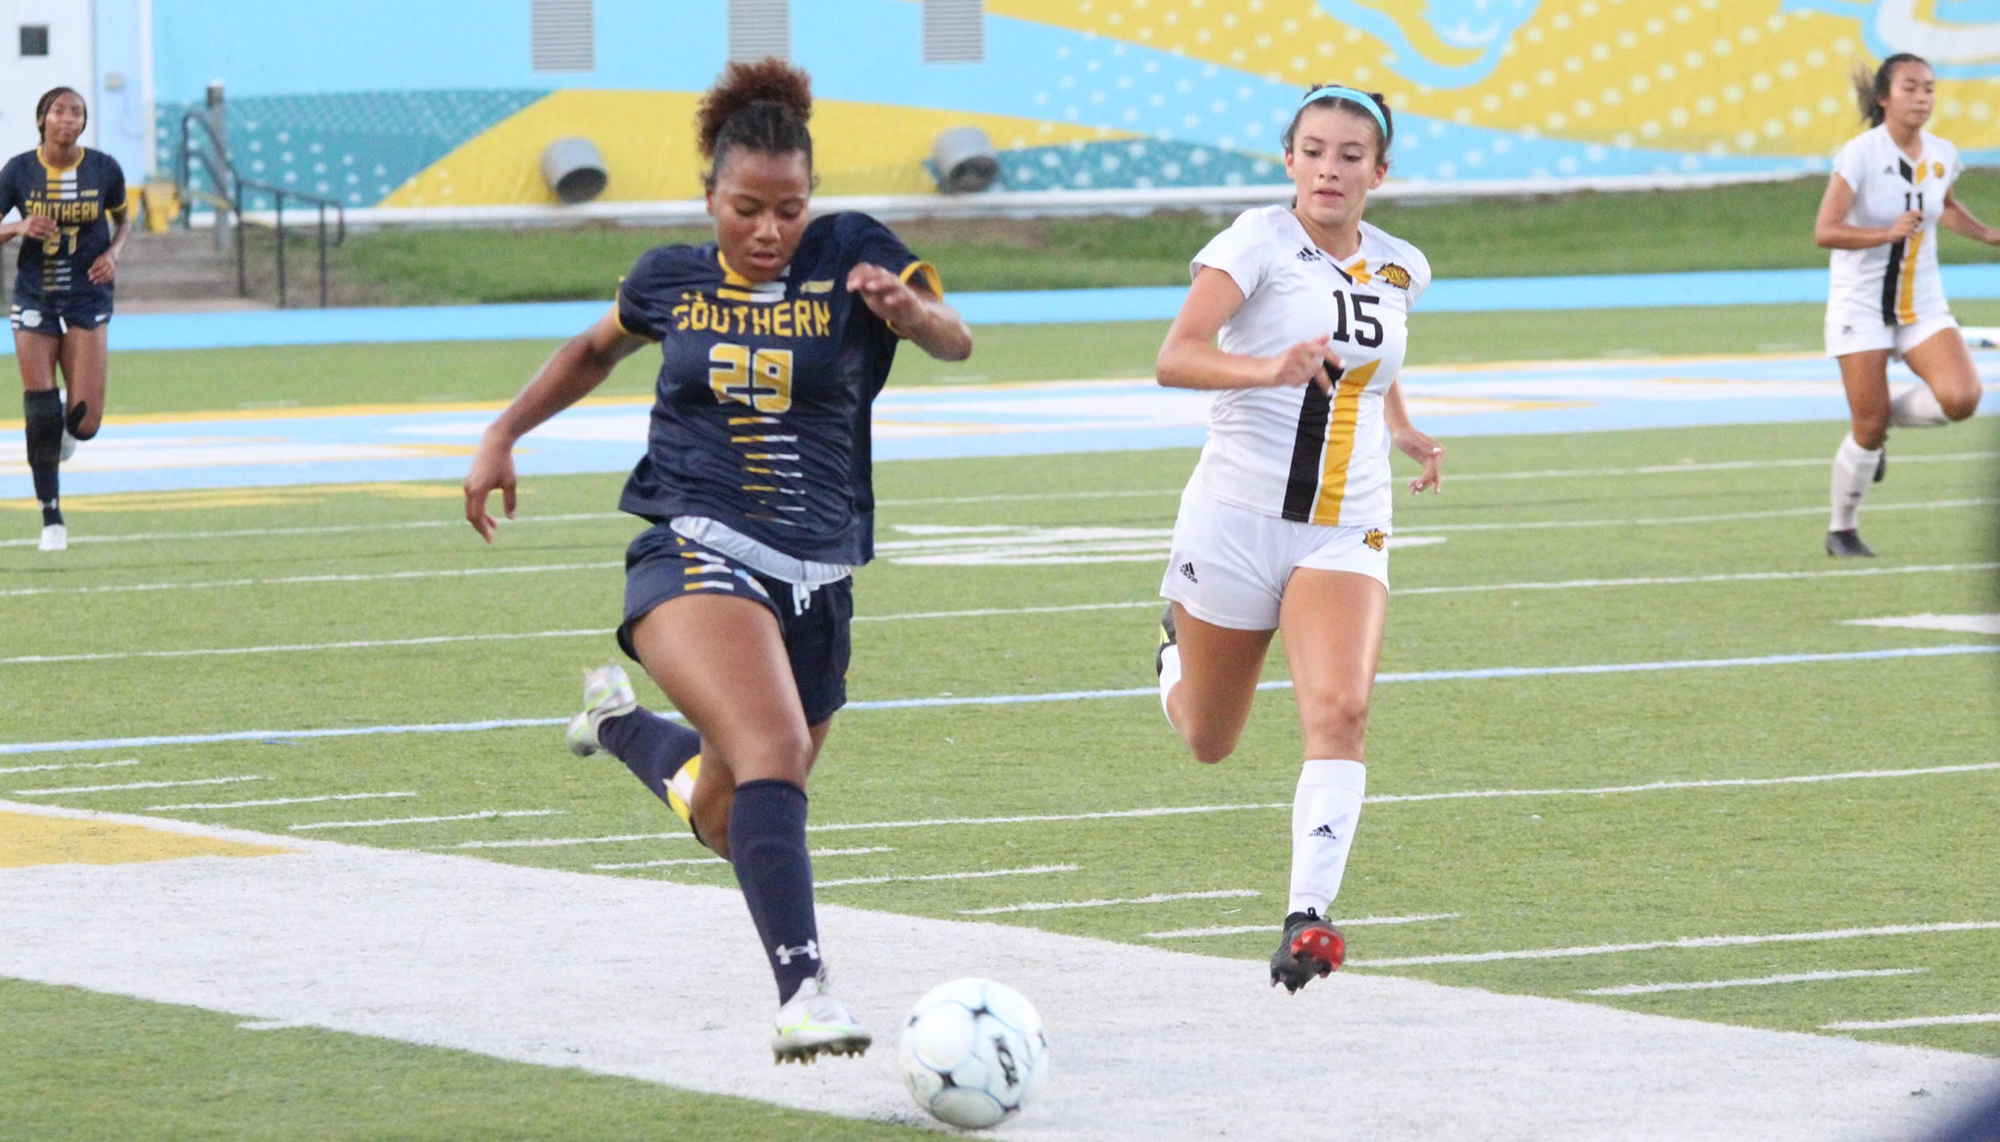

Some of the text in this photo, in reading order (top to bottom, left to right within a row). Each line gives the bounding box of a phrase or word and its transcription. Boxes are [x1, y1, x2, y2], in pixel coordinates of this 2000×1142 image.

[1905, 192, 1923, 221] 11
[672, 299, 832, 337] SOUTHERN
[1333, 289, 1384, 349] 15
[709, 342, 794, 414] 29
